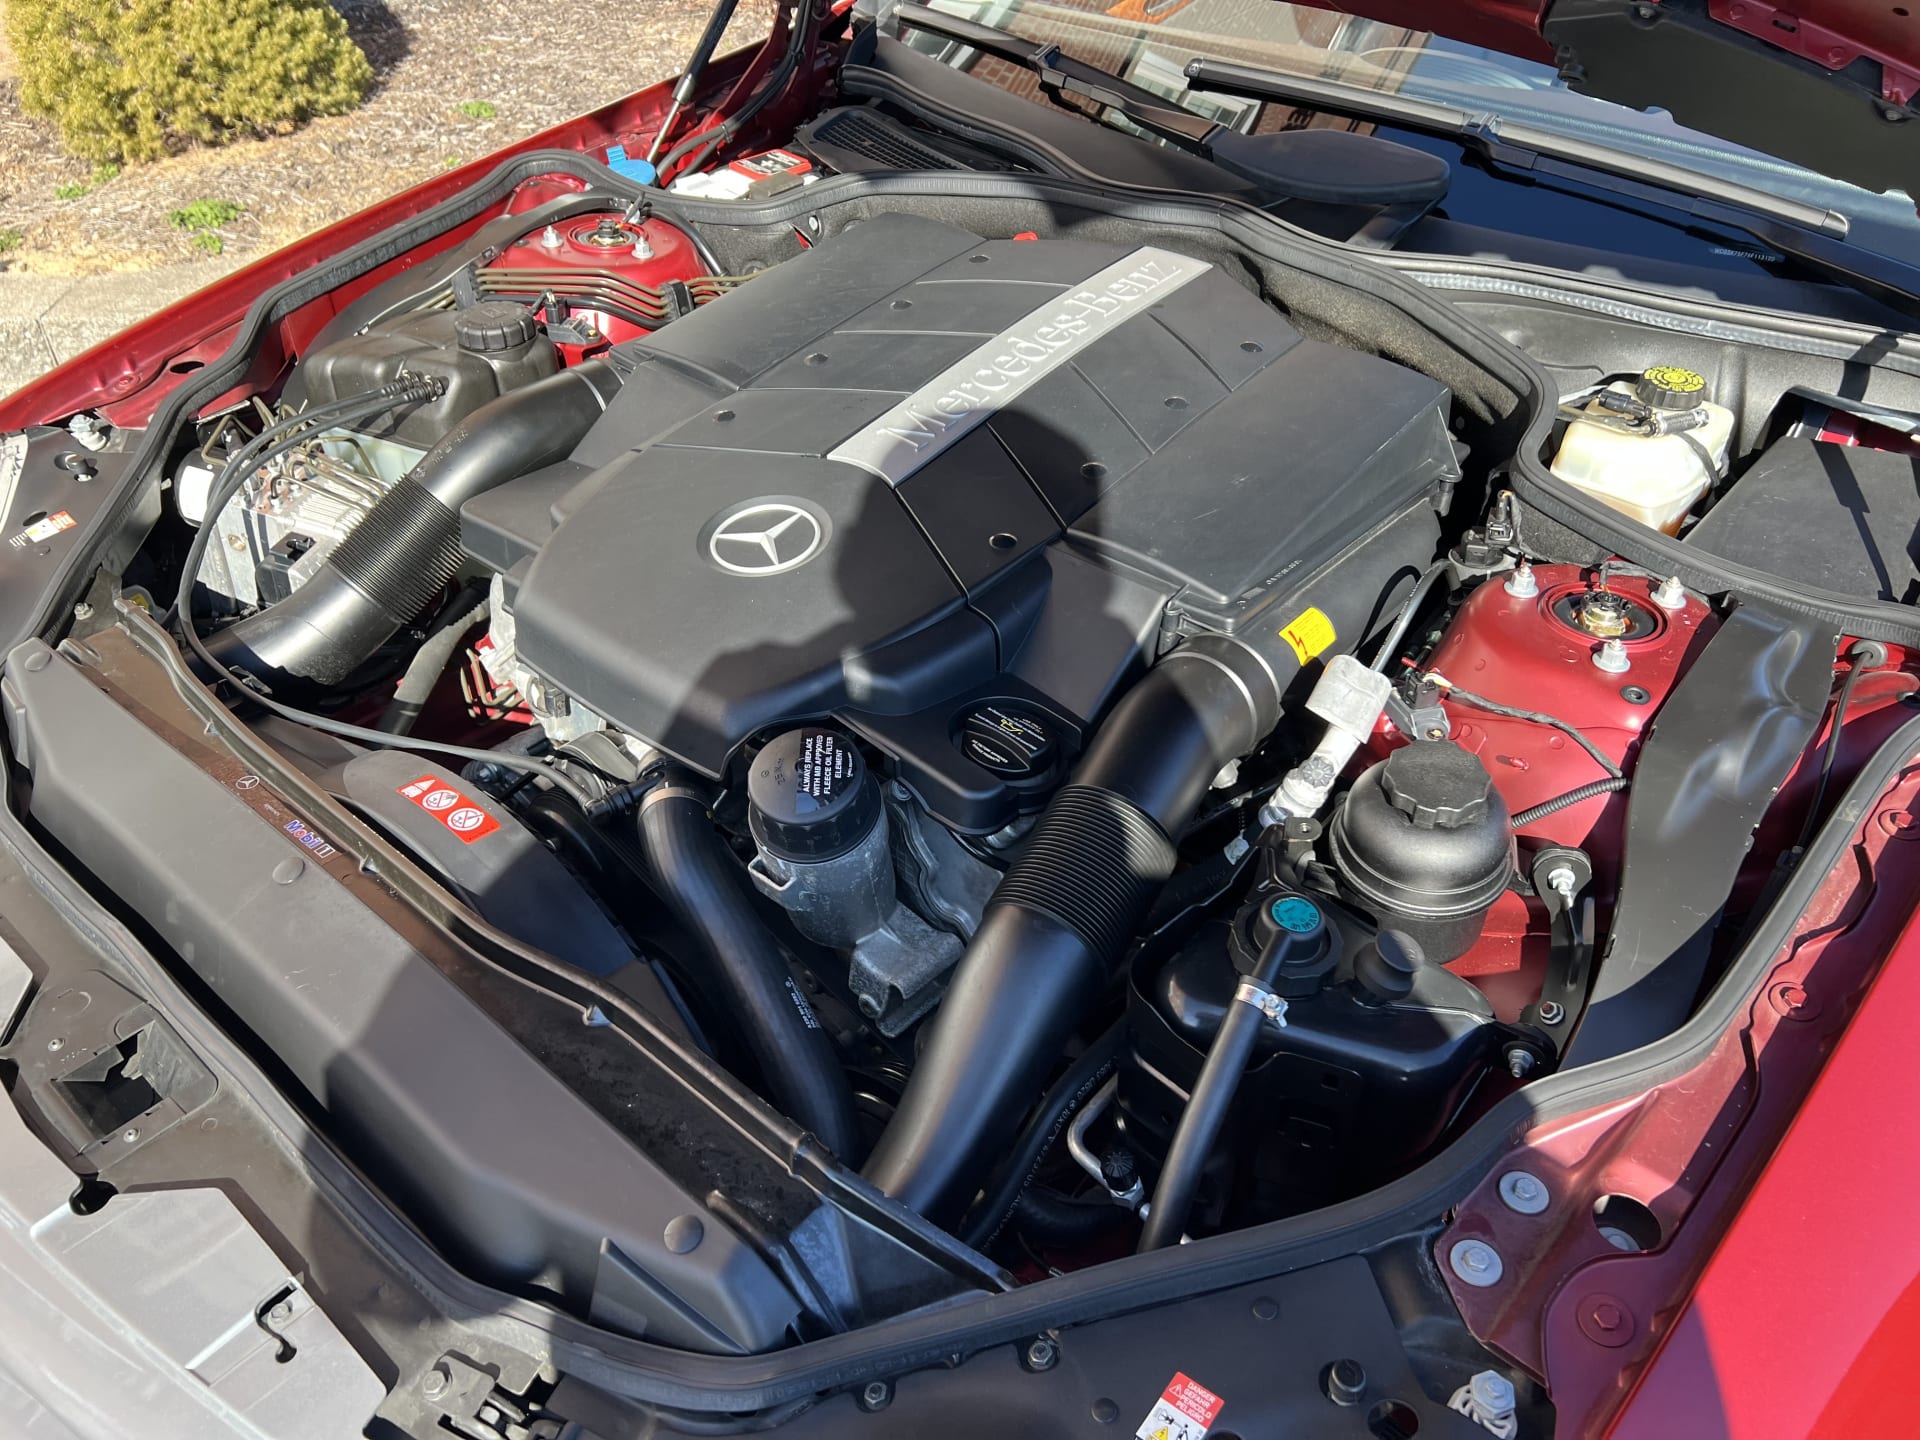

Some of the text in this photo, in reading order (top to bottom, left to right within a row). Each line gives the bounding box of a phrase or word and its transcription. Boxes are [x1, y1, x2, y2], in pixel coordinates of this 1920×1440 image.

[876, 260, 1182, 452] Mercedes-Benz
[805, 737, 813, 763] REPLACE
[835, 749, 843, 779] ELEMENT
[813, 735, 824, 797] WITH MB APPROVED
[824, 736, 834, 794] FLEECE OIL FILTER
[283, 819, 324, 849] Mobil
[1180, 1393, 1212, 1420] PERICOLO
[1184, 1388, 1211, 1409] GEFAHR
[1188, 1382, 1216, 1404] DANGER
[1176, 1400, 1204, 1423] PELIGRO
